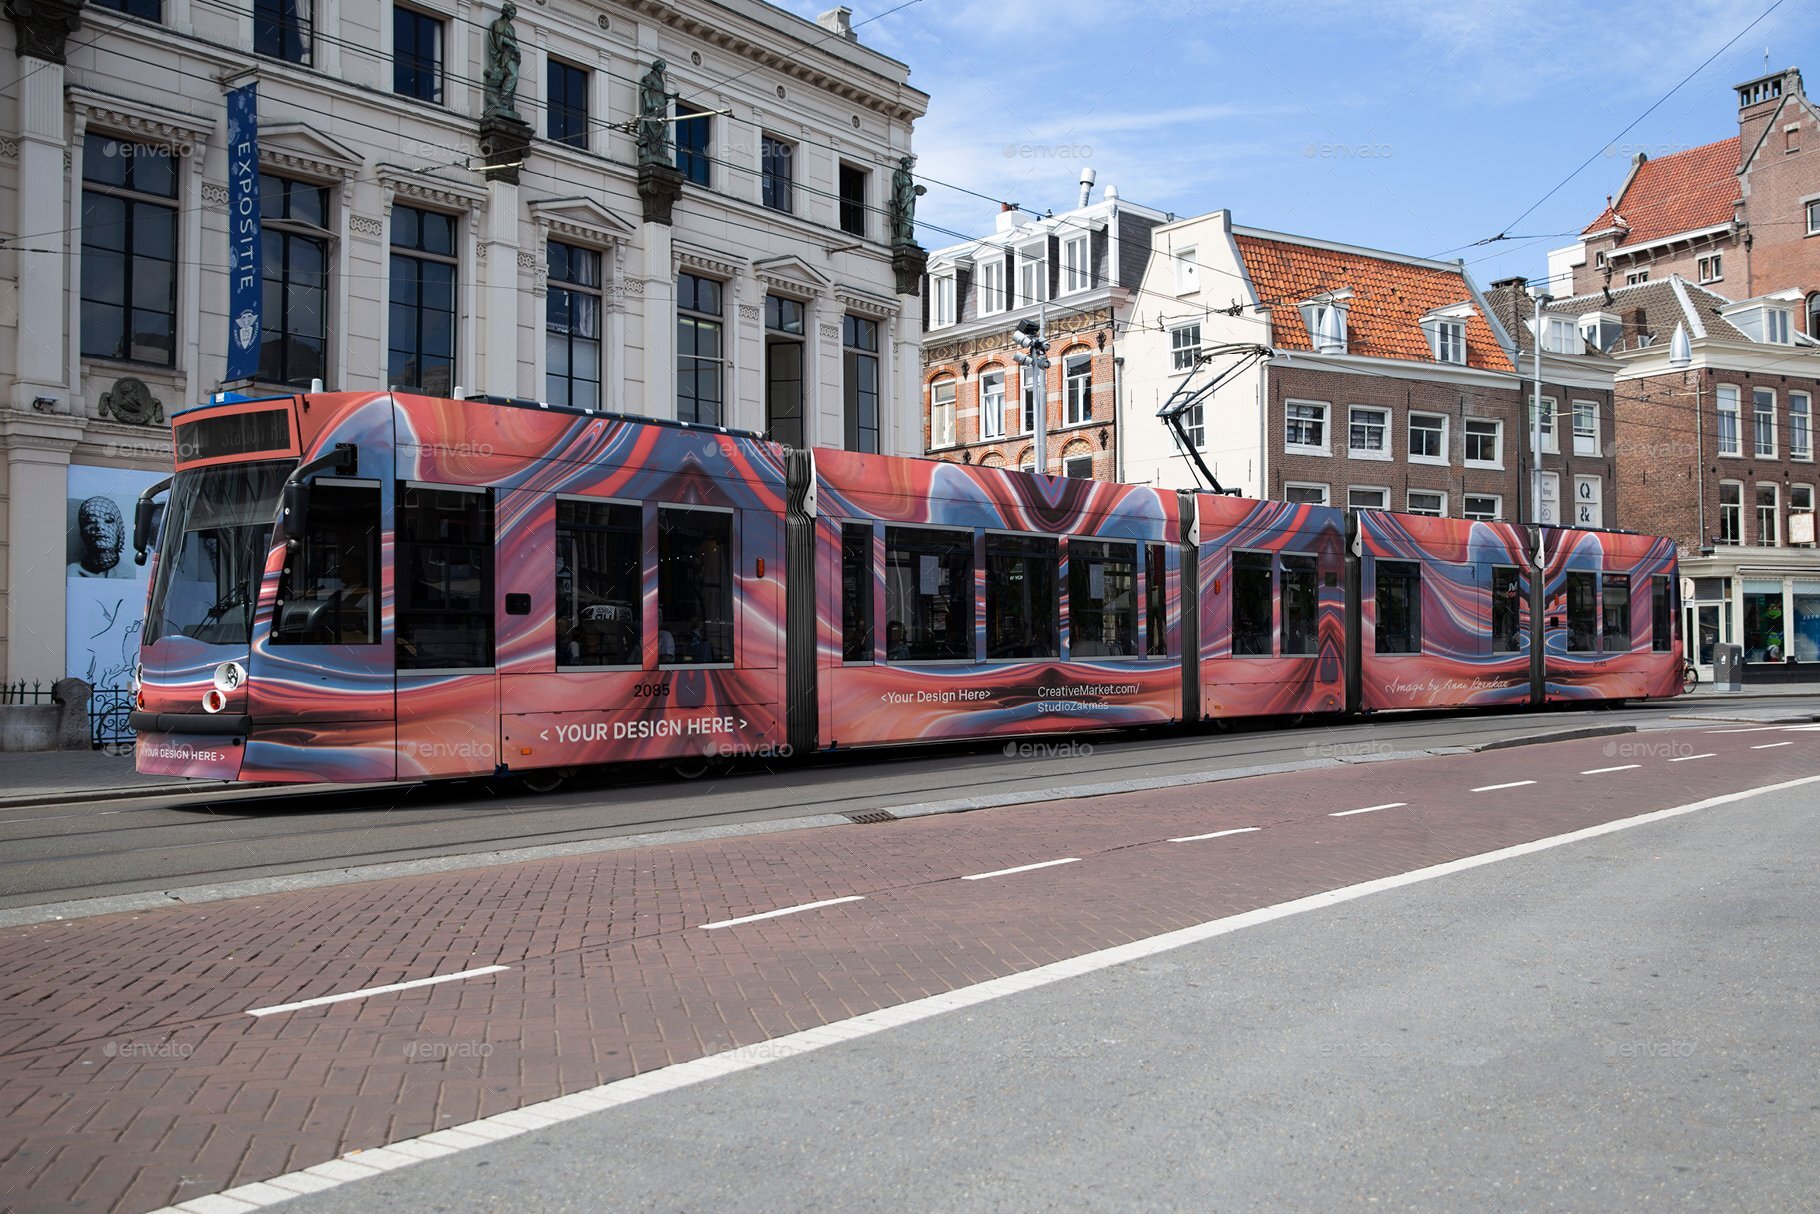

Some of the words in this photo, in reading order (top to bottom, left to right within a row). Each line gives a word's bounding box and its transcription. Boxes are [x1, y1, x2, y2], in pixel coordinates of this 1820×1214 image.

[238, 142, 254, 290] EXPOSITIE
[1580, 482, 1590, 499] Q
[633, 684, 671, 697] 2085
[917, 690, 956, 703] Design
[1037, 683, 1140, 697] CreativeMarket.com/
[1385, 676, 1424, 700] Image
[1427, 679, 1440, 703] by
[1037, 700, 1109, 712] StudioZakmes
[555, 722, 608, 743] YOUR
[614, 719, 681, 740] DESIGN
[687, 716, 734, 735] HERE
[144, 748, 159, 758] YOUR
[160, 749, 189, 760] DESIGN
[191, 751, 217, 761] HERE
